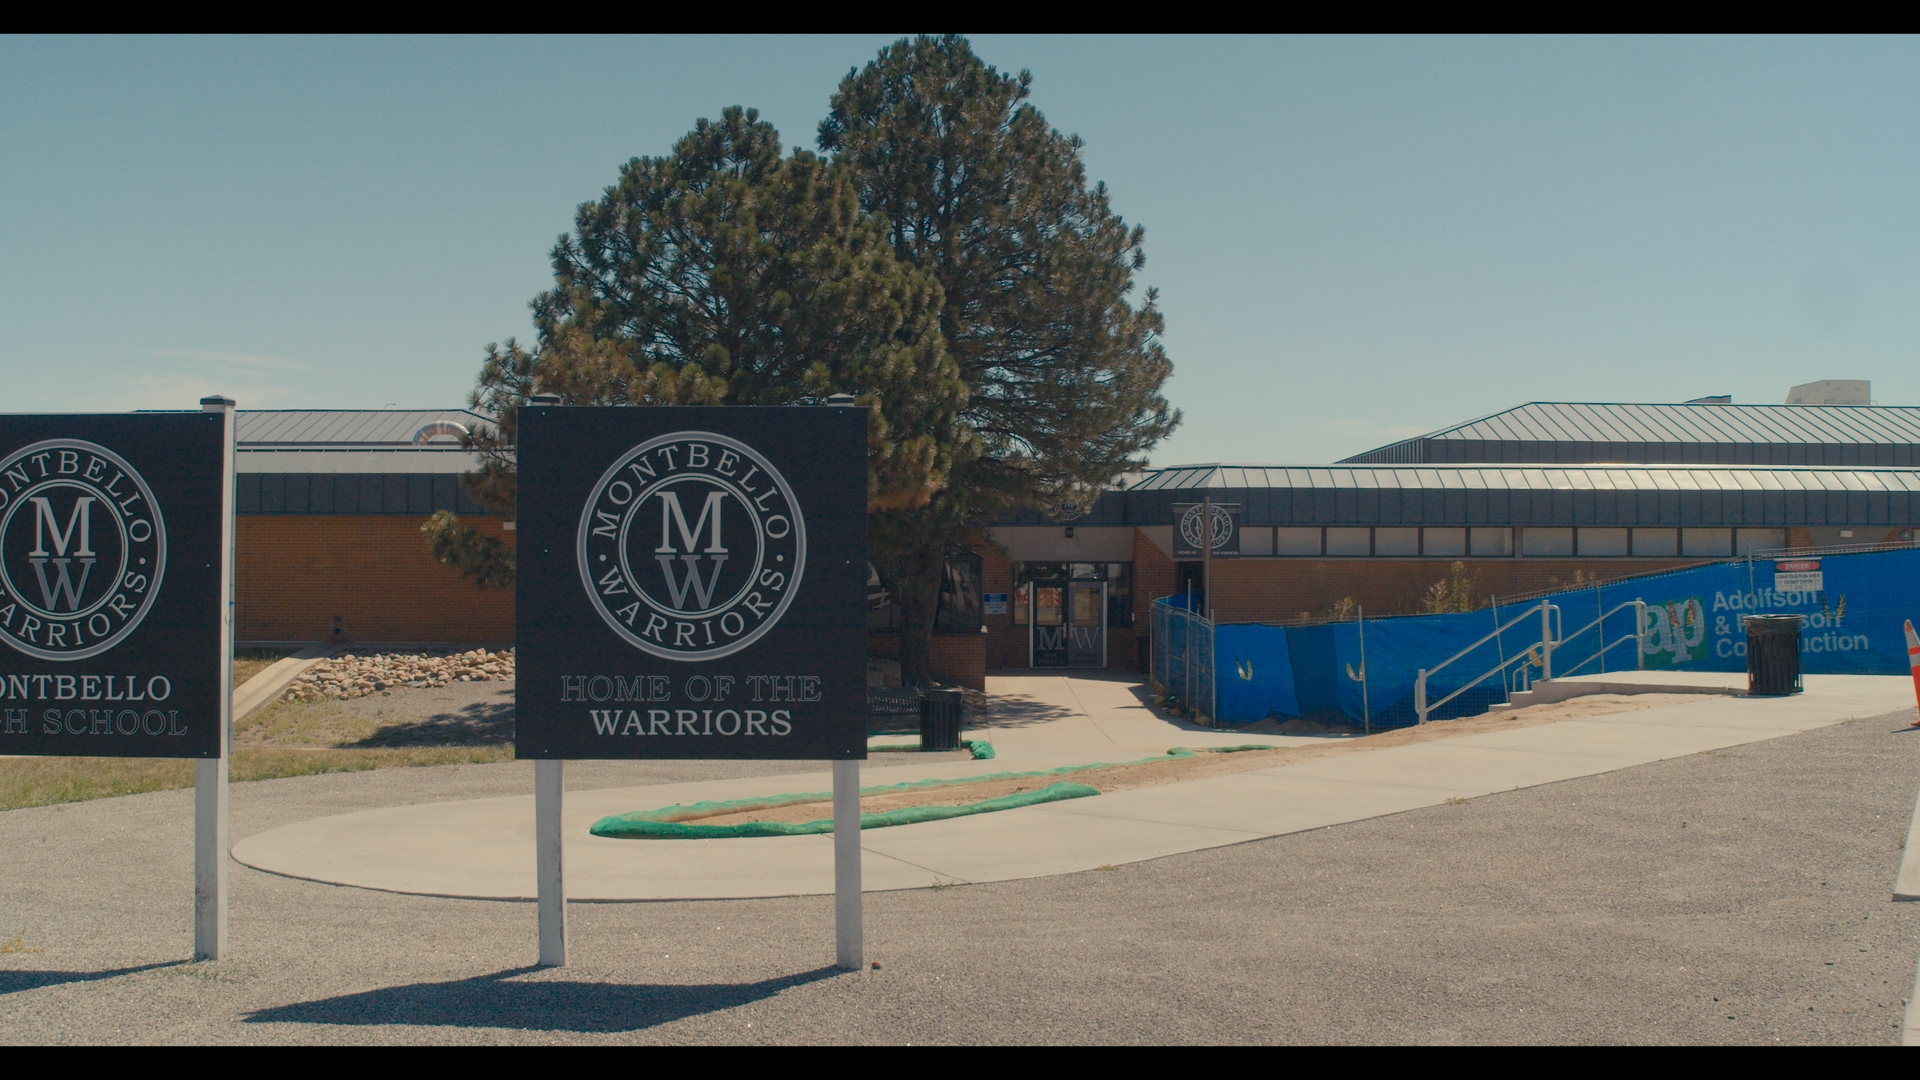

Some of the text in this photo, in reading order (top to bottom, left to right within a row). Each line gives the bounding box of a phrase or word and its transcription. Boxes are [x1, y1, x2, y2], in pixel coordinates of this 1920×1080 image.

[593, 444, 789, 540] MONTBELLO
[29, 496, 96, 557] M
[655, 491, 728, 553] M
[0, 569, 148, 646] ARRIORS
[29, 557, 96, 611] W
[599, 566, 785, 646] WARRIORS
[655, 554, 728, 609] W
[1712, 587, 1817, 612] Adolfson
[1037, 626, 1099, 650] M W
[1715, 615, 1731, 635] &
[561, 675, 822, 702] HOME OF THE
[43, 708, 188, 736] SCHOOL
[589, 709, 792, 736] WARRIORS
